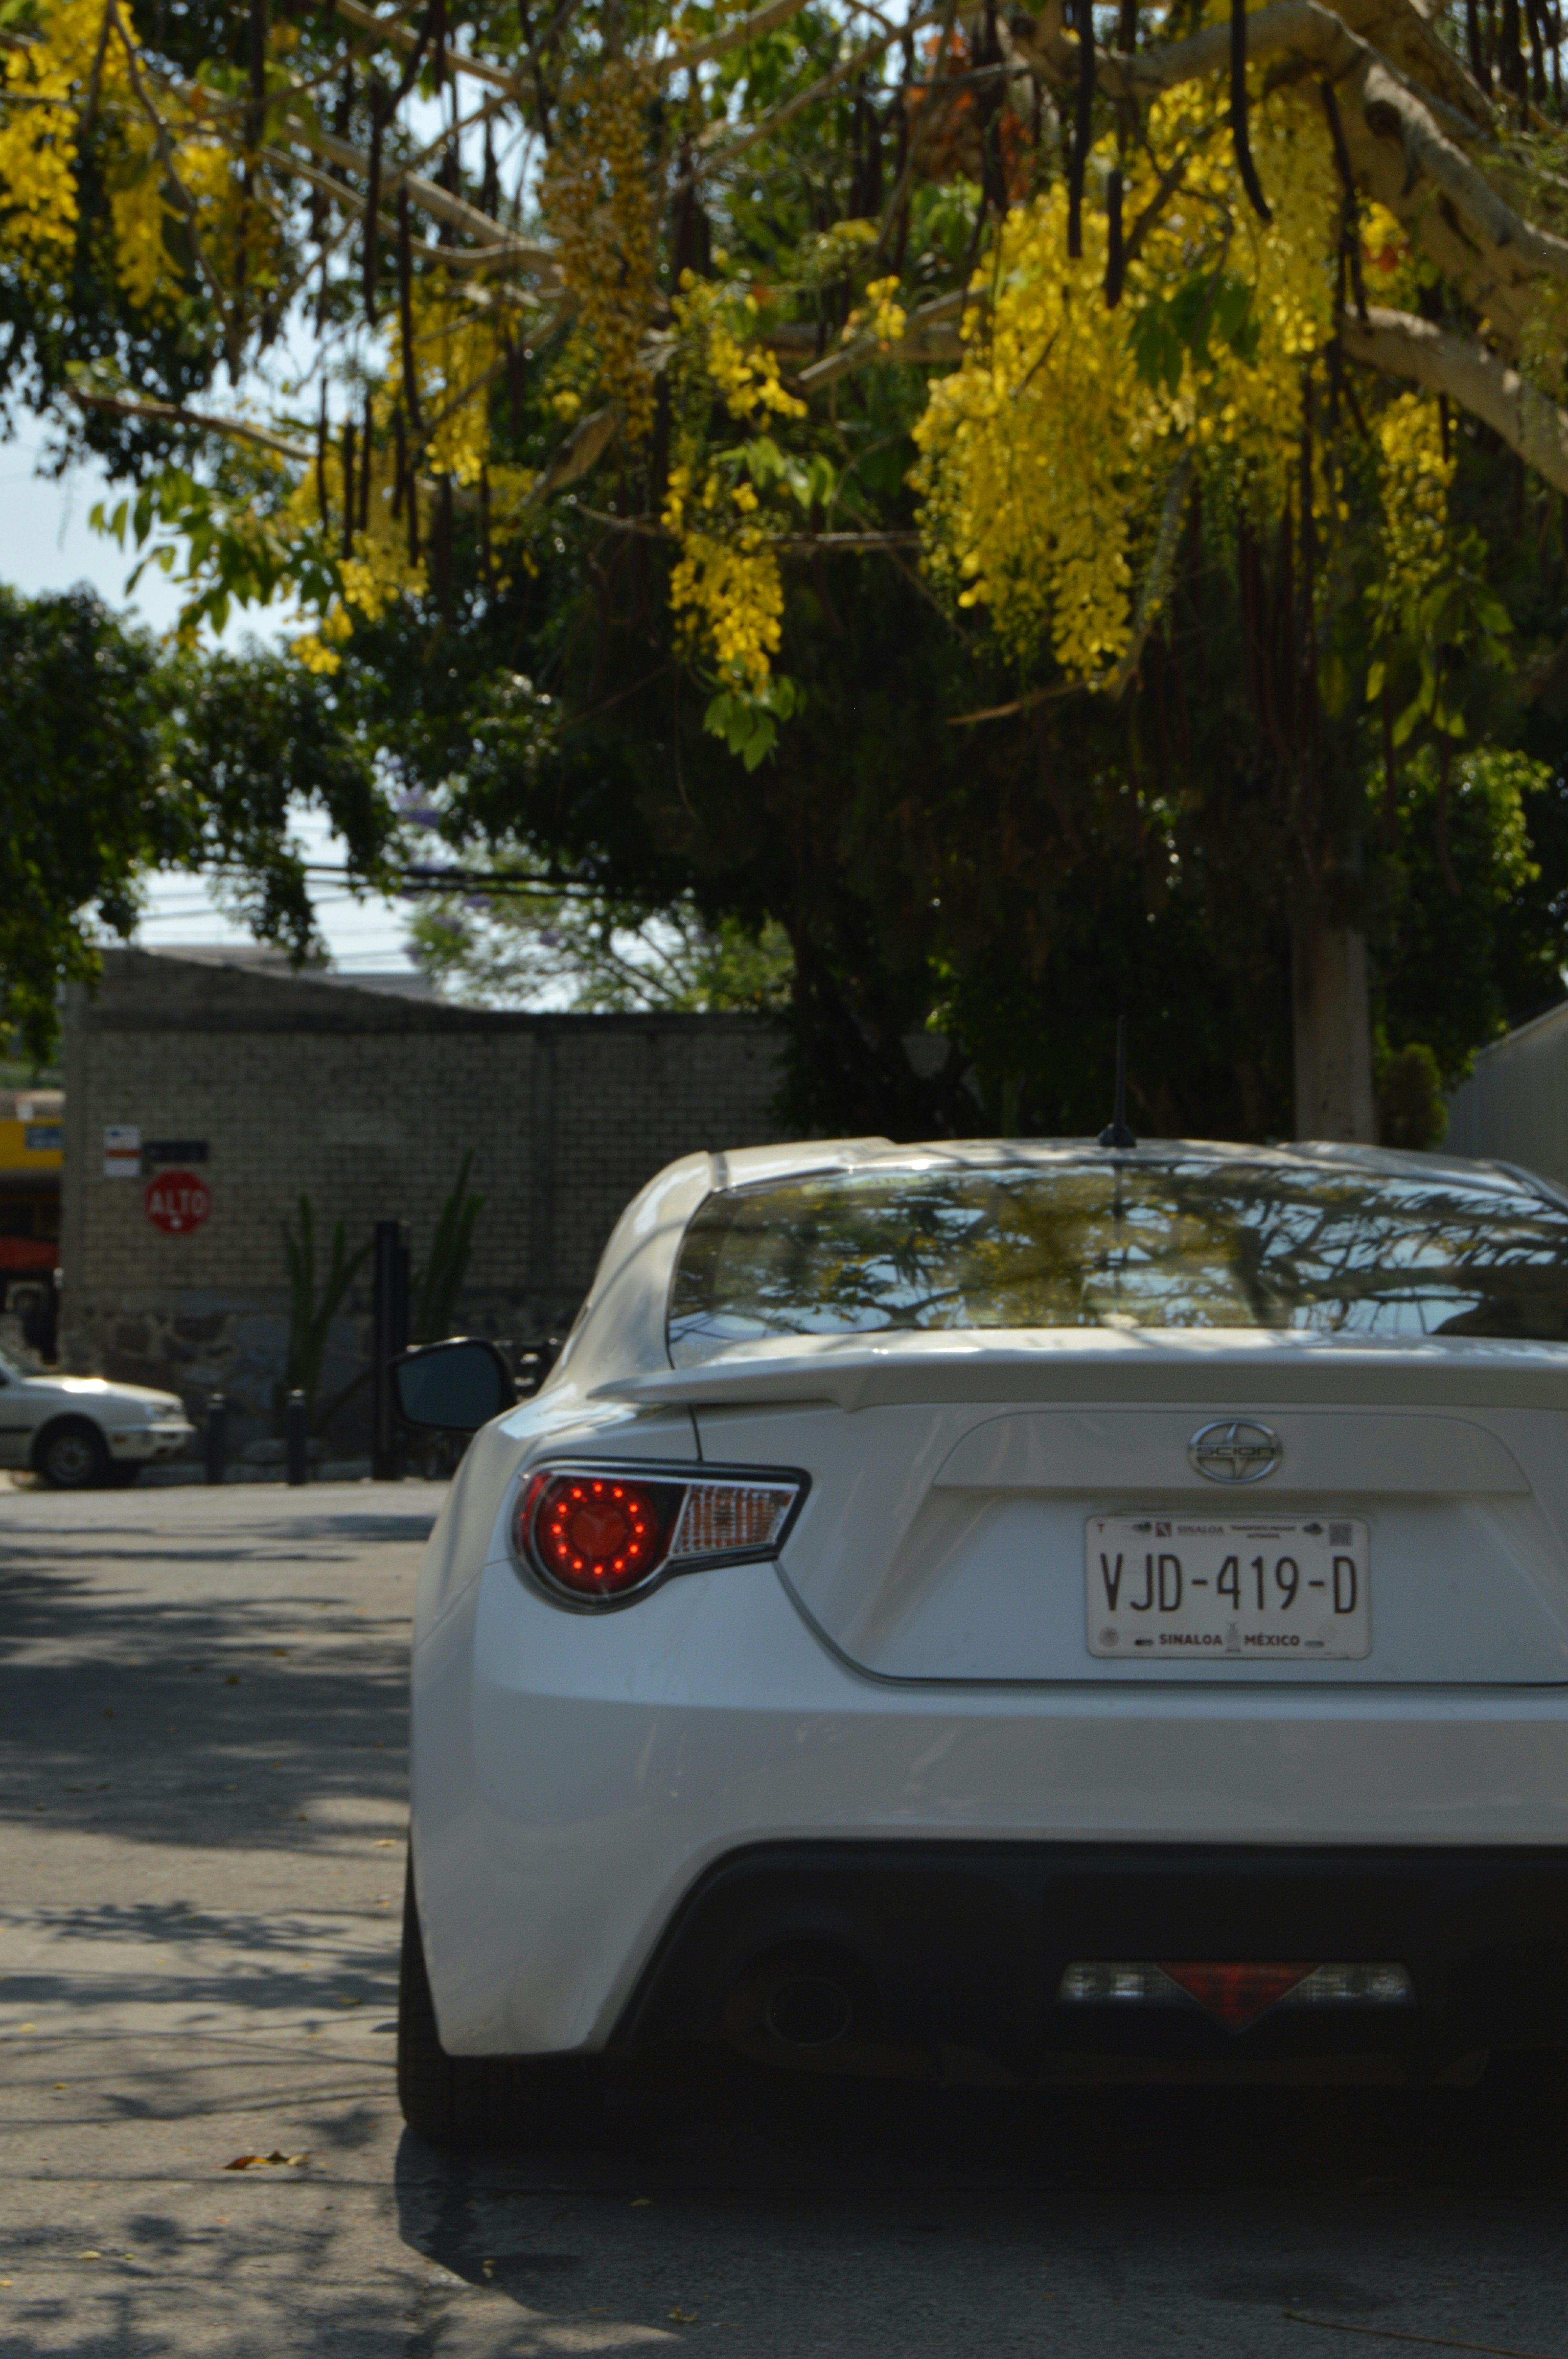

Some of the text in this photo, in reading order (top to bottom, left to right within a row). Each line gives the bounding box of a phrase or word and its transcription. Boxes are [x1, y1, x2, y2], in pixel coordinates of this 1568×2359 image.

[149, 1189, 205, 1215] ALTO
[1177, 1525, 1224, 1534] SINALOA
[1100, 1554, 1357, 1614] VJD-419-D
[1159, 1632, 1299, 1646] SINALOA MÉXICO
